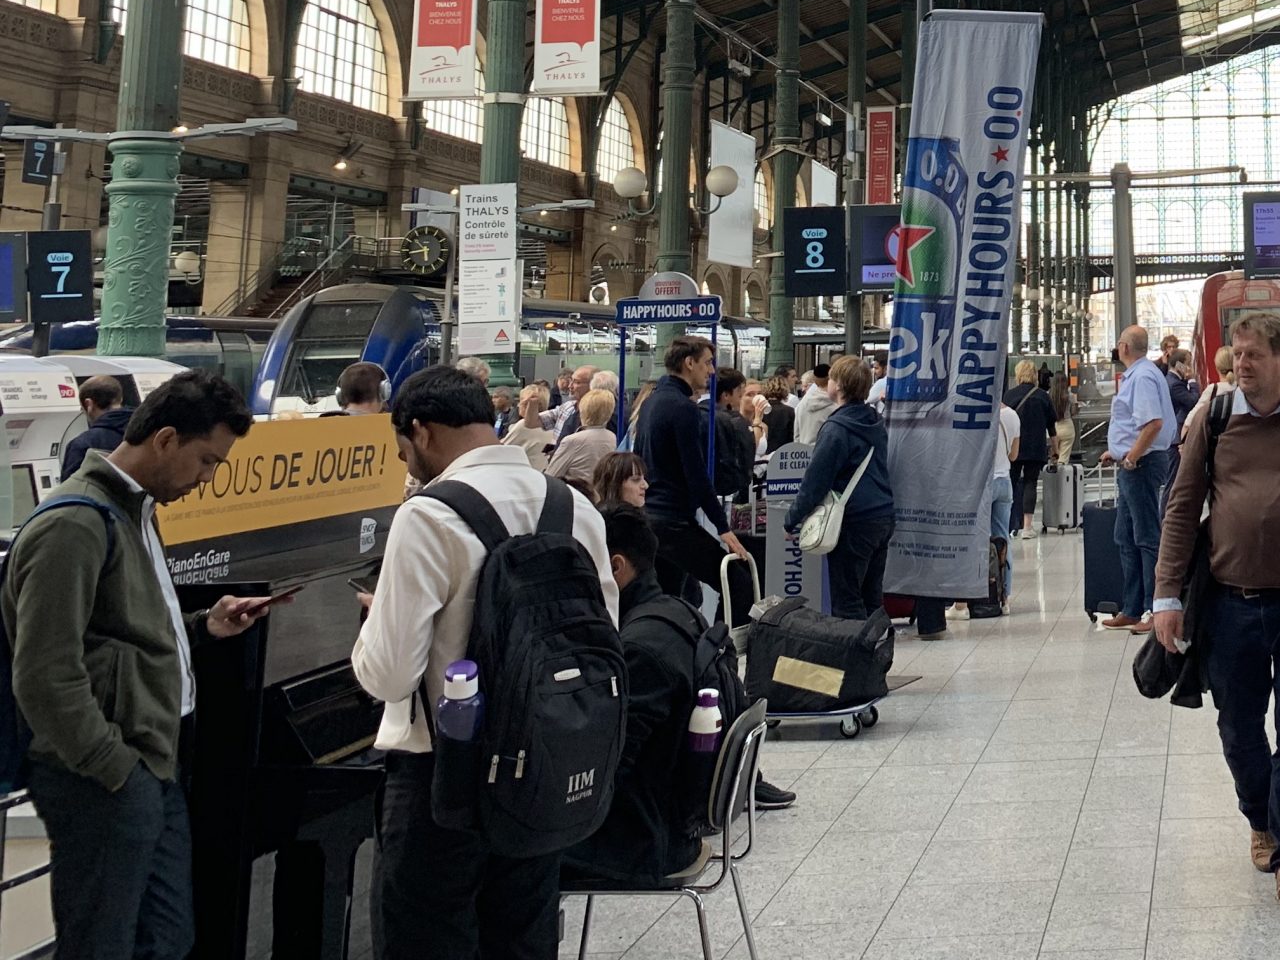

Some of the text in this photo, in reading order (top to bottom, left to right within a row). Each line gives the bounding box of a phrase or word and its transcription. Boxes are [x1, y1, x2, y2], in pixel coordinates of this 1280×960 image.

[421, 76, 462, 84] THALYS
[35, 152, 45, 172] 7
[466, 194, 498, 203] Trains
[466, 206, 509, 216] THALYS
[465, 220, 505, 229] Contrôle
[465, 231, 509, 240] de sûreté
[966, 170, 1015, 298] HOURS
[806, 241, 825, 268] 8
[51, 266, 71, 292] 7
[920, 271, 939, 282] 1873
[655, 287, 681, 295] OFFERTE
[623, 305, 657, 319] HAPPY
[657, 304, 692, 317] HOURS
[952, 302, 1001, 430] HAPPY
[780, 452, 789, 460] BE
[270, 452, 303, 490] DE
[307, 444, 375, 486] JOUER
[779, 462, 788, 470] BE
[769, 483, 788, 491] HAPPY
[568, 768, 595, 793] IIM
